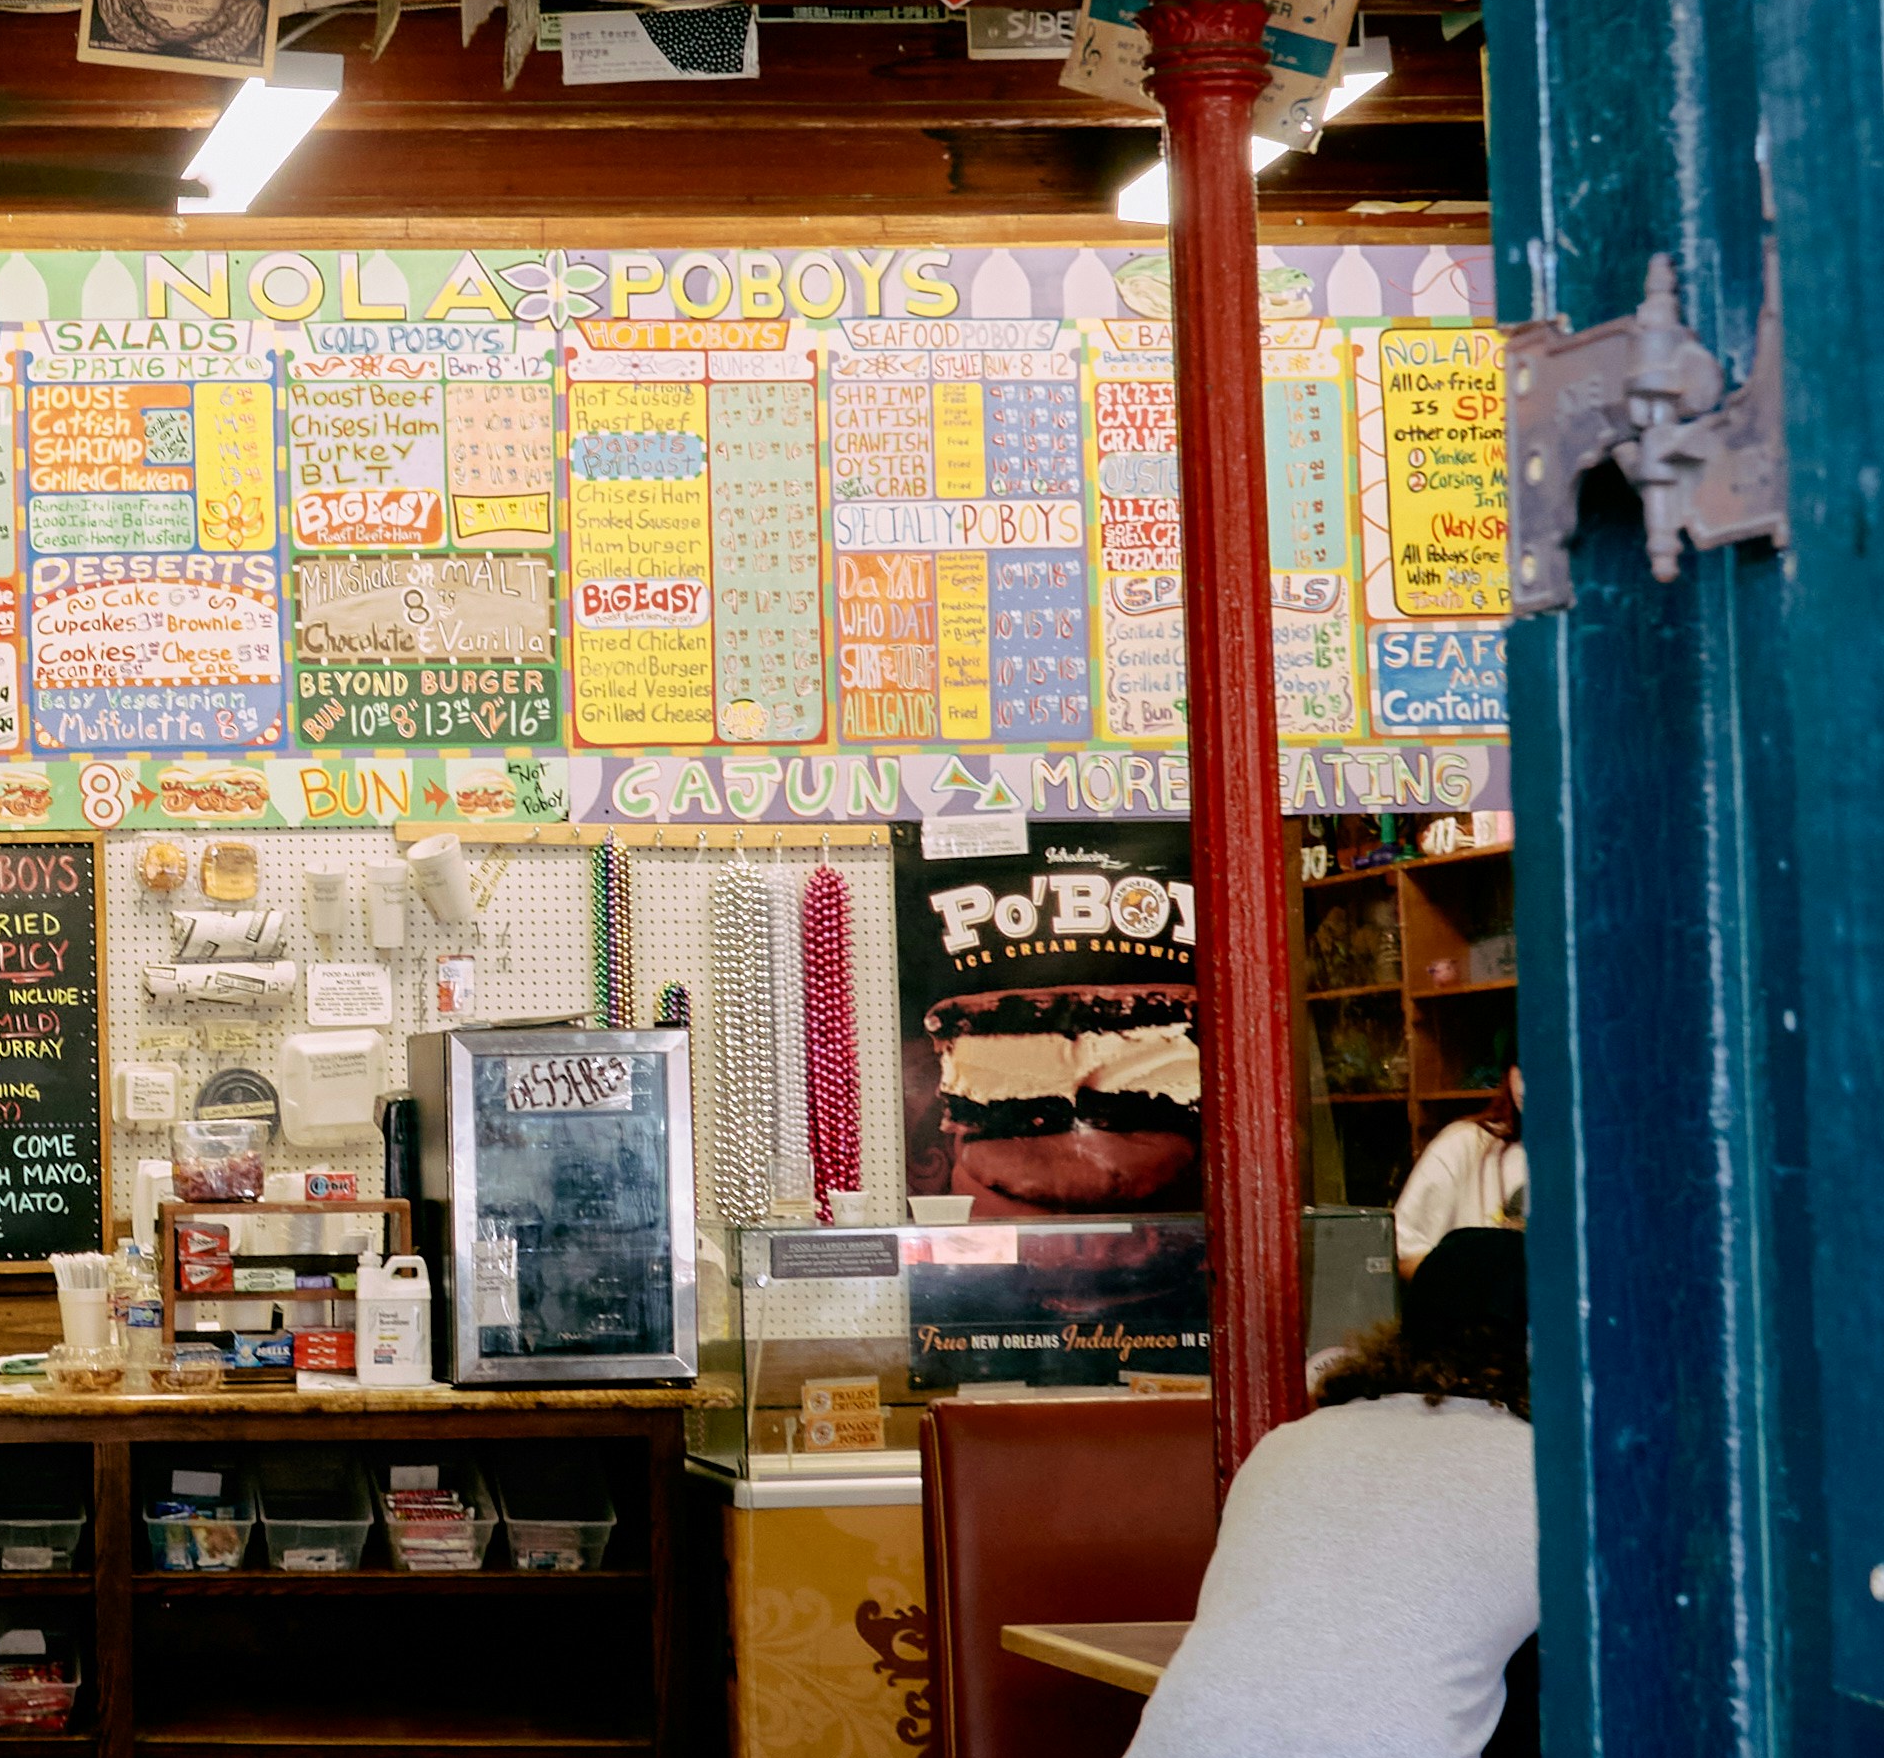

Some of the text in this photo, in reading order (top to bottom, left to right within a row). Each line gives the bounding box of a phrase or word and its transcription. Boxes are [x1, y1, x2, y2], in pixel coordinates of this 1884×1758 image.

[147, 251, 959, 320] NOLA POBOYS
[56, 322, 238, 353] SALADS
[852, 323, 960, 348] SEAFOOD
[47, 357, 241, 379] SPRING MIX
[32, 386, 131, 410] HOUSE
[291, 384, 435, 408] Roast Beef
[32, 411, 131, 437] Catfish
[291, 412, 440, 438] Chisesi Ham
[834, 409, 929, 428] CATFISH
[33, 437, 143, 465] SHRIMP
[834, 432, 930, 453] CRAWFISH
[836, 456, 926, 478] OYSTER
[32, 554, 277, 594] DESSERTS
[37, 612, 136, 636] Cupcakes
[37, 642, 136, 664] Cookies
[299, 670, 544, 698] BEYOND BURGER
[299, 768, 411, 819] BUN
[1030, 756, 1191, 814] MORE
[12, 1134, 77, 1160] COME
[971, 1323, 1177, 1362] NEW ORLEANS Indulgence
